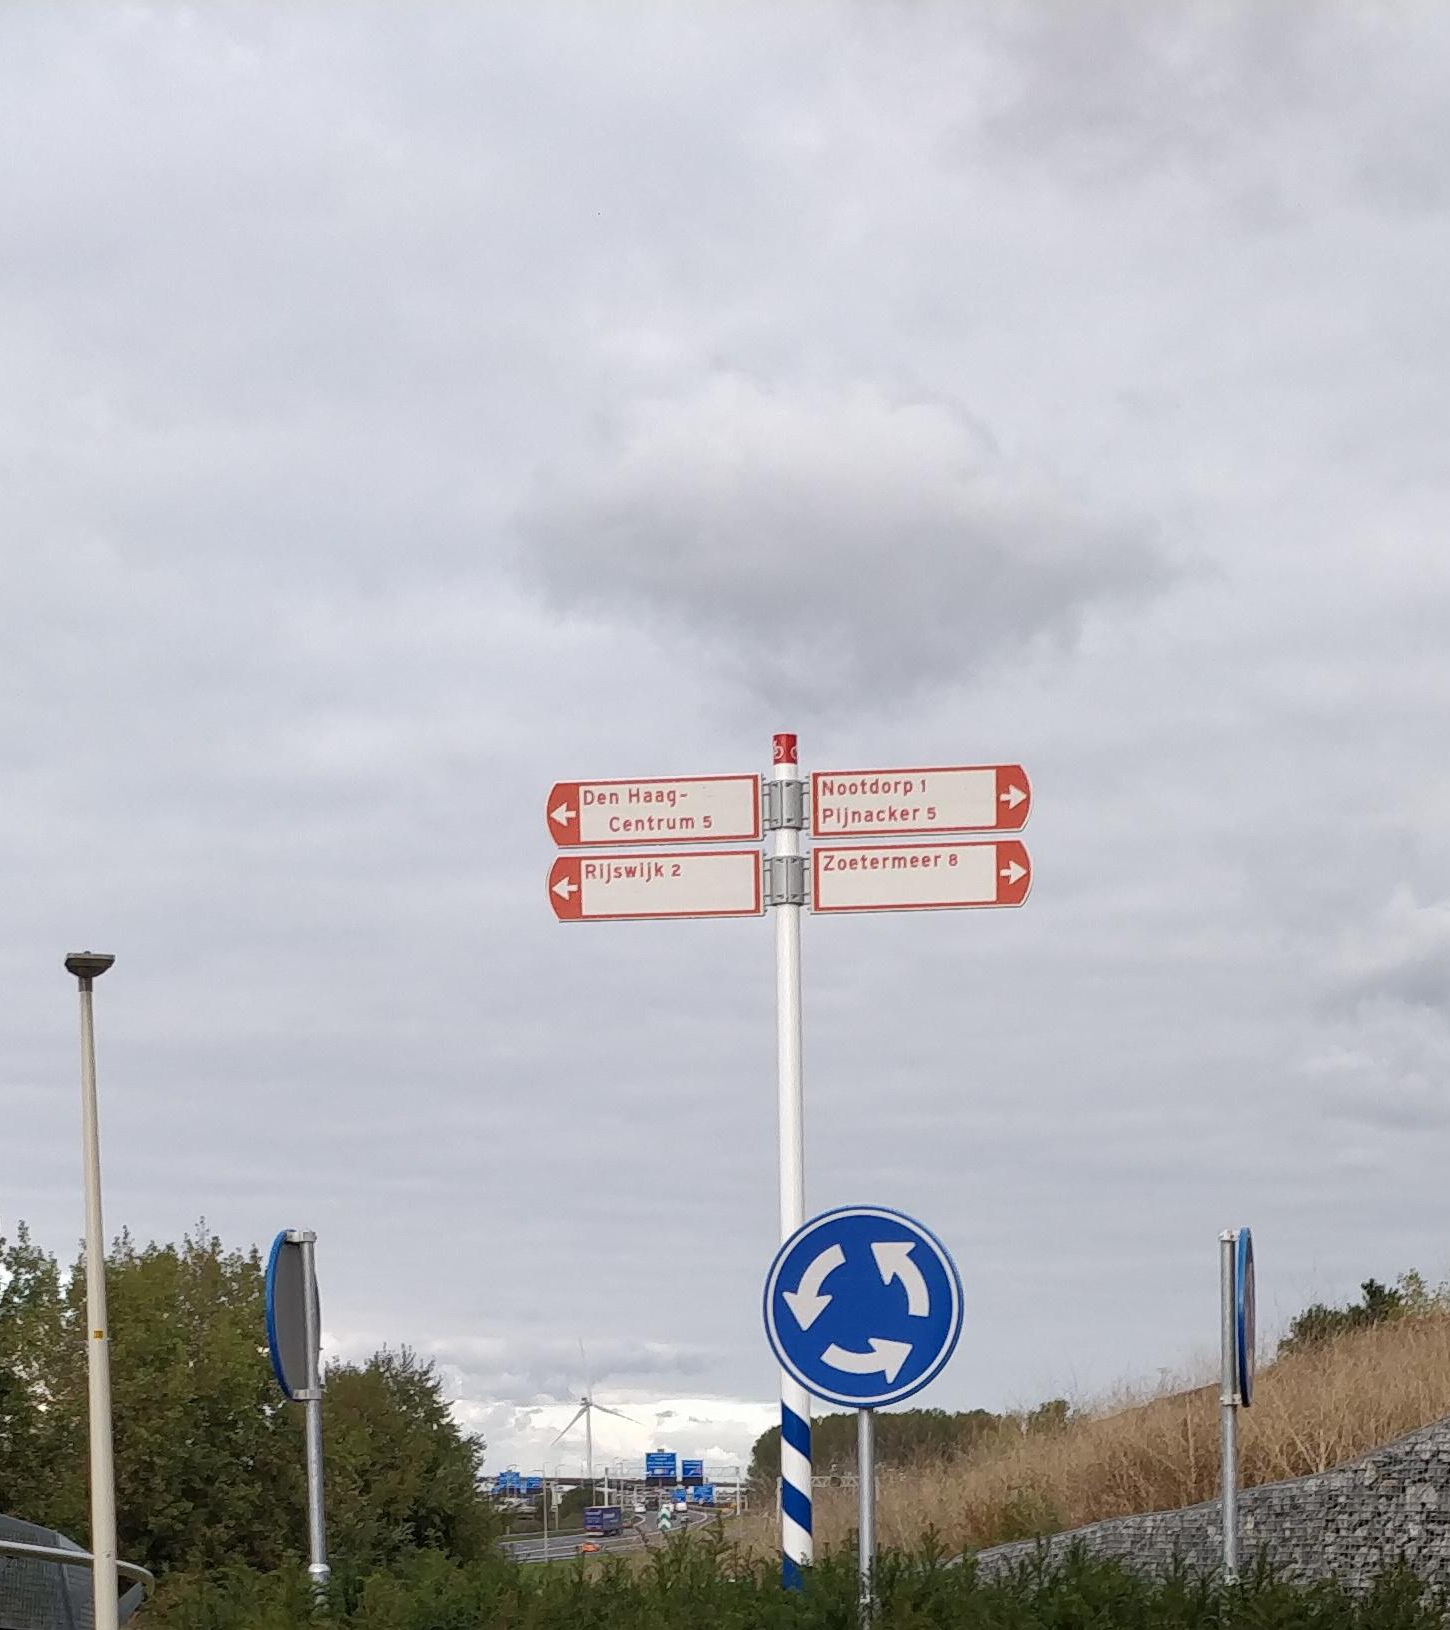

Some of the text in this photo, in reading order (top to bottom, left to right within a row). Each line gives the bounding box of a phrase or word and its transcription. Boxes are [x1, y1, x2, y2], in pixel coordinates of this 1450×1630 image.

[822, 778, 926, 796] Nootdorp 1
[583, 788, 688, 808] Den Haag-
[609, 815, 712, 832] Centrum 5
[822, 805, 936, 828] Pijnacker 5
[823, 853, 958, 871] Zoetermeer 8
[585, 862, 681, 884] Rijswijk 2
